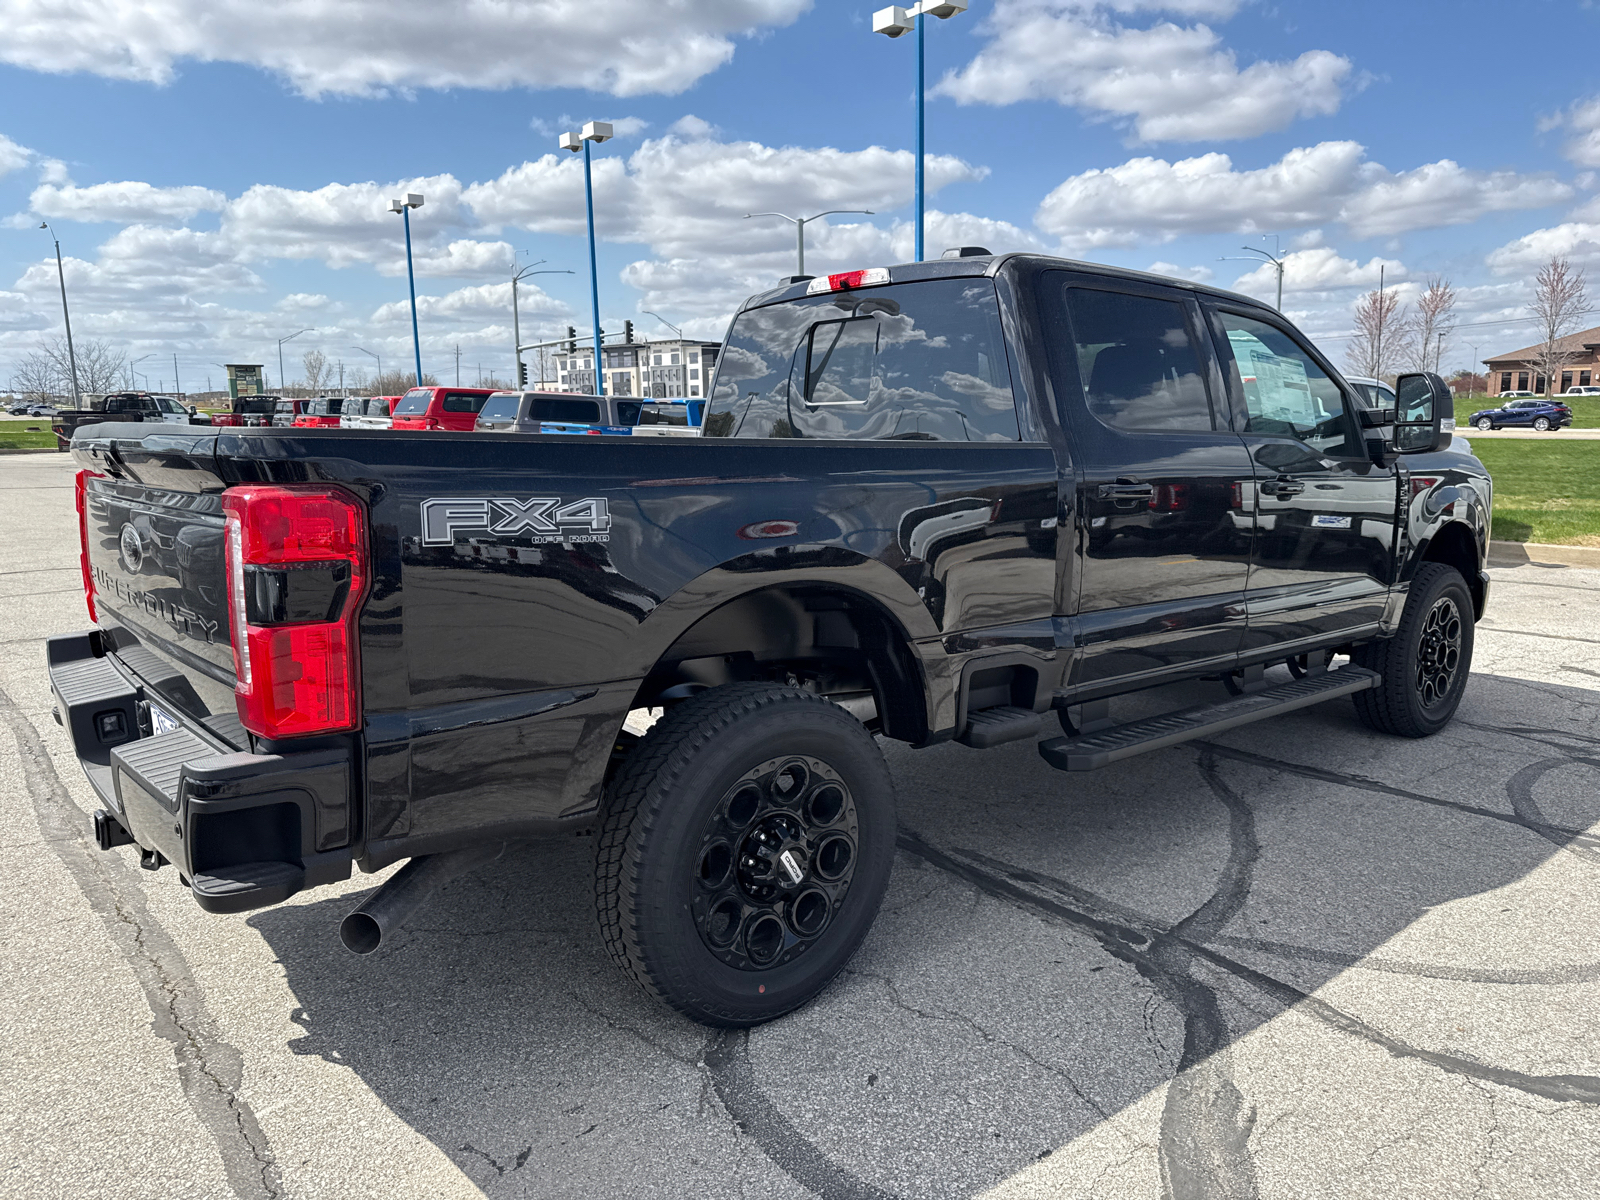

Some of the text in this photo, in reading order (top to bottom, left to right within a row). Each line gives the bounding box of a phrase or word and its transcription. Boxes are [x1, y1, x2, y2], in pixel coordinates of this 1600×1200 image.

[420, 497, 612, 547] FX4
[531, 535, 609, 545] OFF ROAD
[143, 592, 218, 645] DUTY
